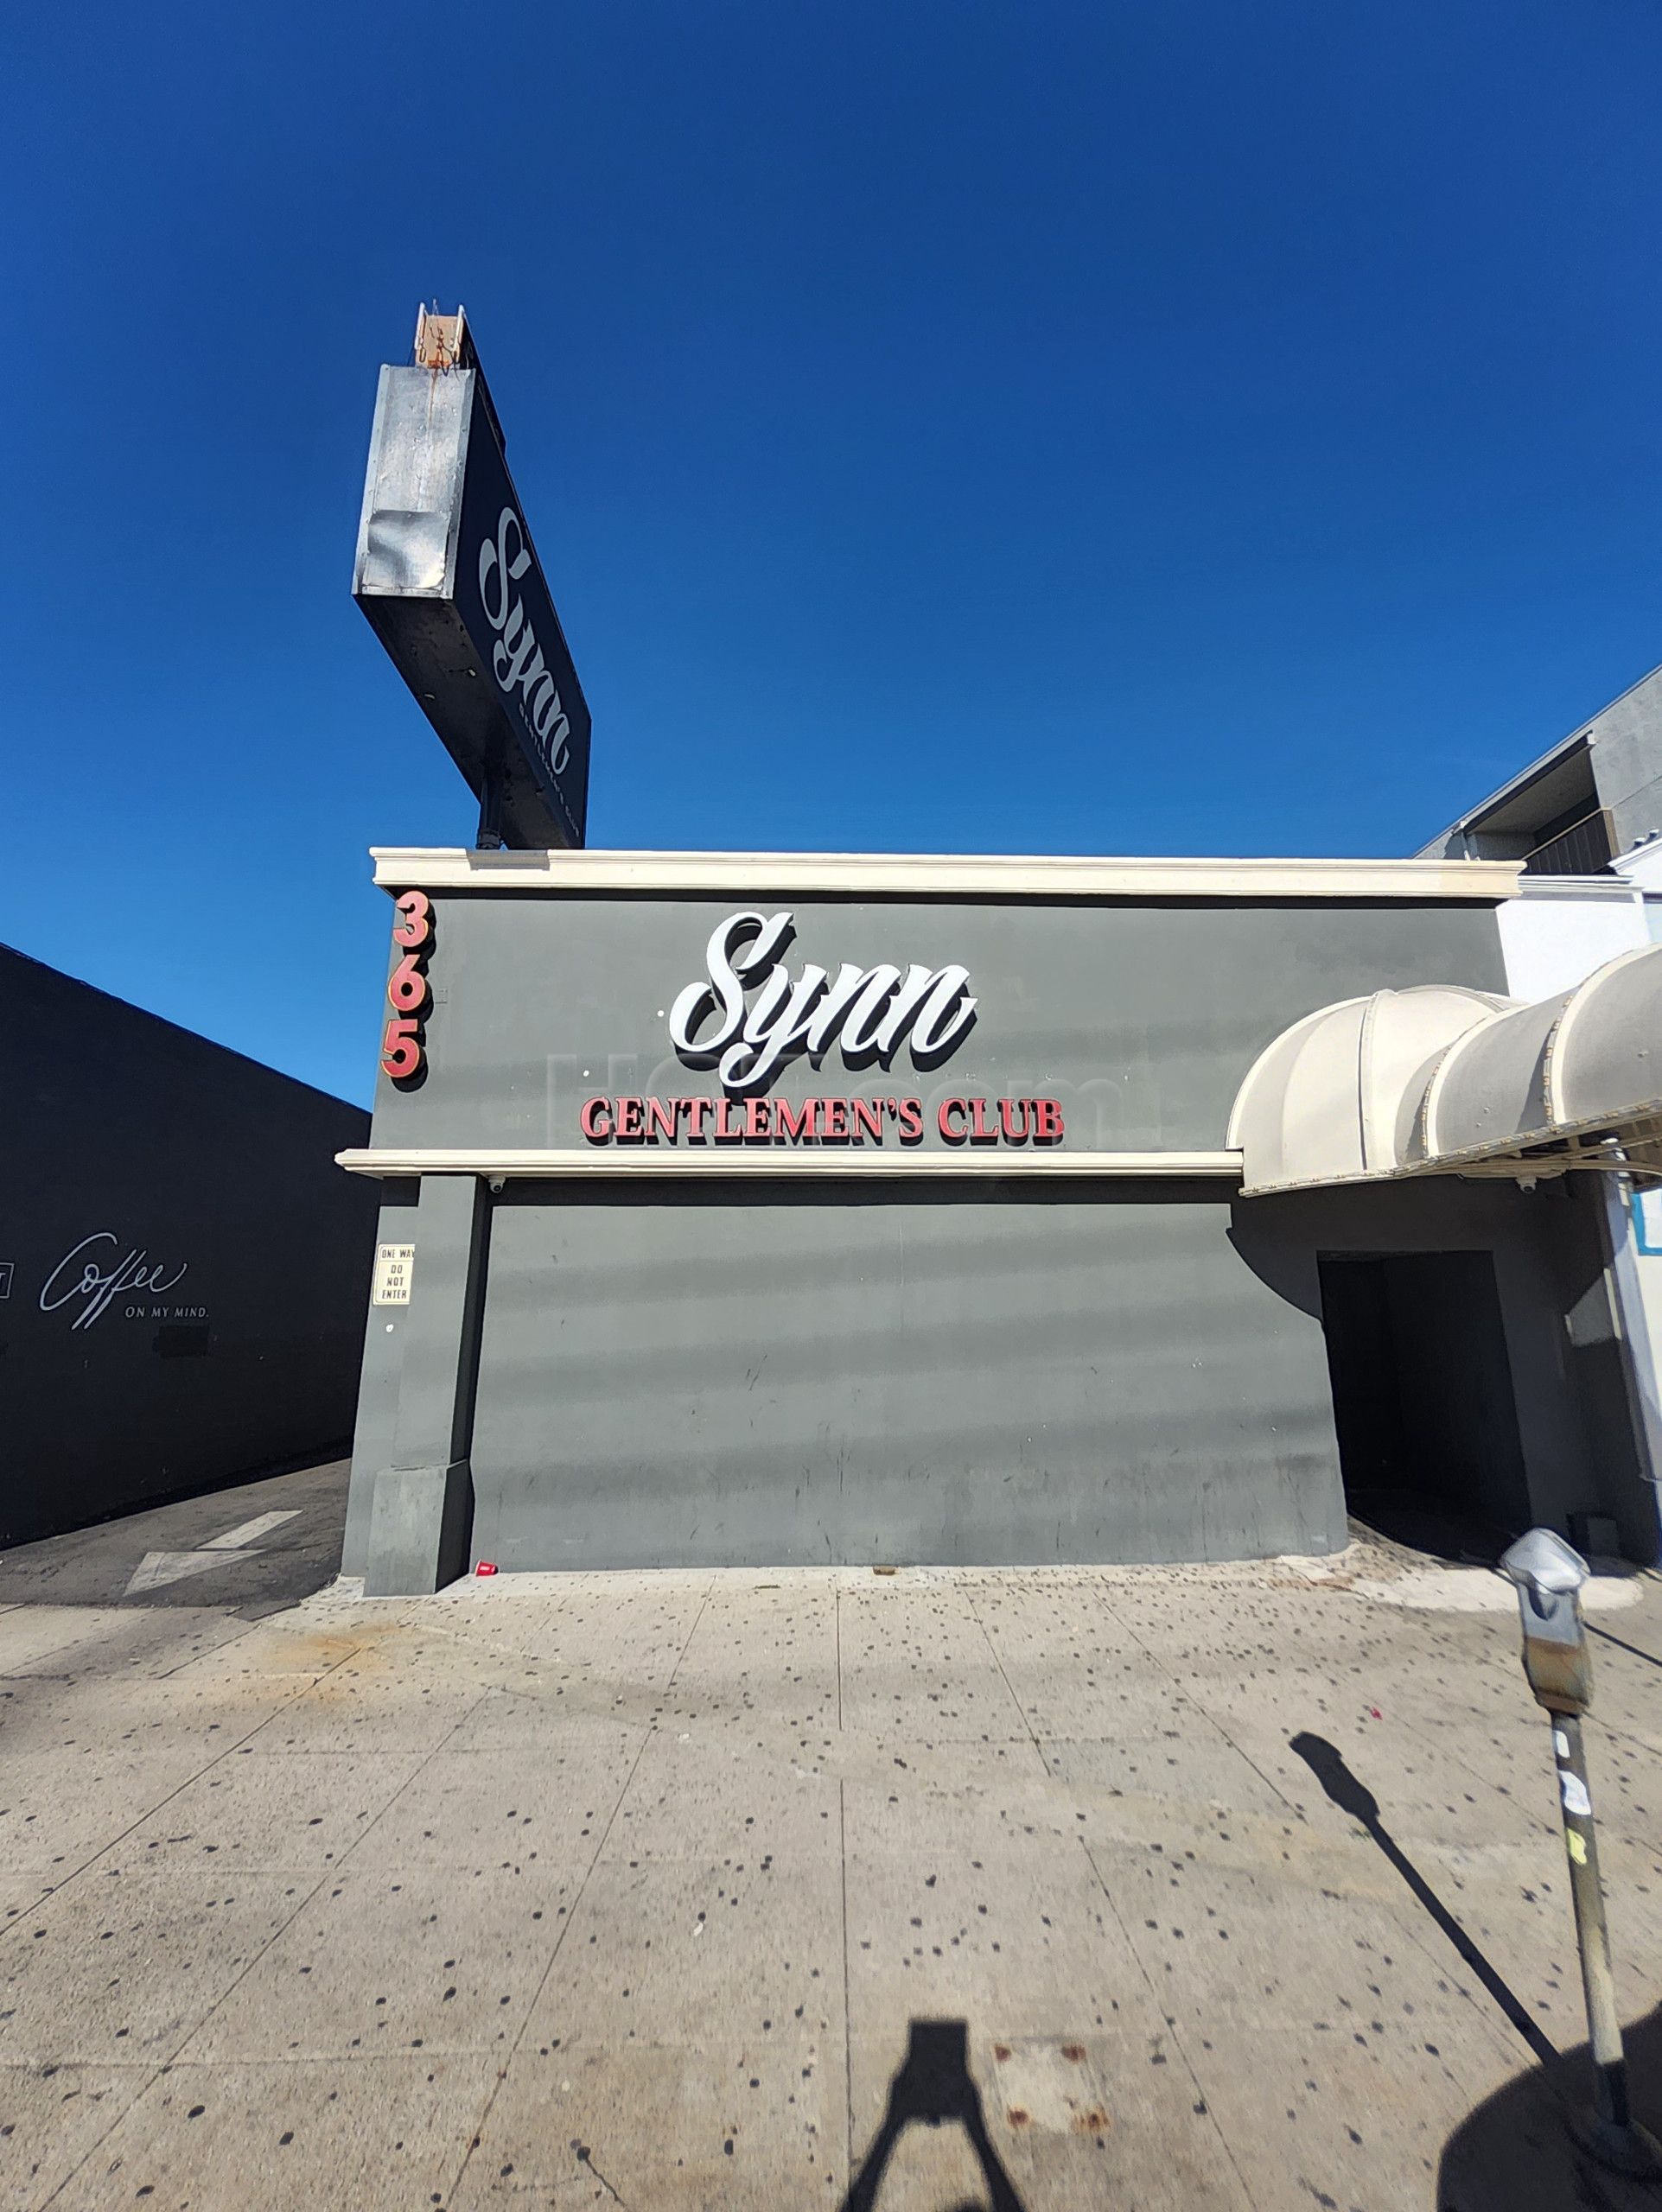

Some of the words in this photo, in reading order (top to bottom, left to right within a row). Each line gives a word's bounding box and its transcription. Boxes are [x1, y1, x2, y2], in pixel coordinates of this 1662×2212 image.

[479, 506, 570, 775] Synn
[669, 911, 978, 1088] Synn
[580, 1096, 924, 1141] GENTLEMEN'S
[938, 1097, 1066, 1140] CLUB
[381, 1249, 395, 1259] ONE
[399, 1249, 416, 1259] WAY
[391, 1264, 403, 1274] DO
[40, 1232, 188, 1330] Coffee
[386, 1277, 404, 1287] NOT
[381, 1289, 407, 1300] ENTER
[125, 1306, 145, 1318] ON
[151, 1306, 169, 1318] MY
[175, 1306, 209, 1318] MIND.
